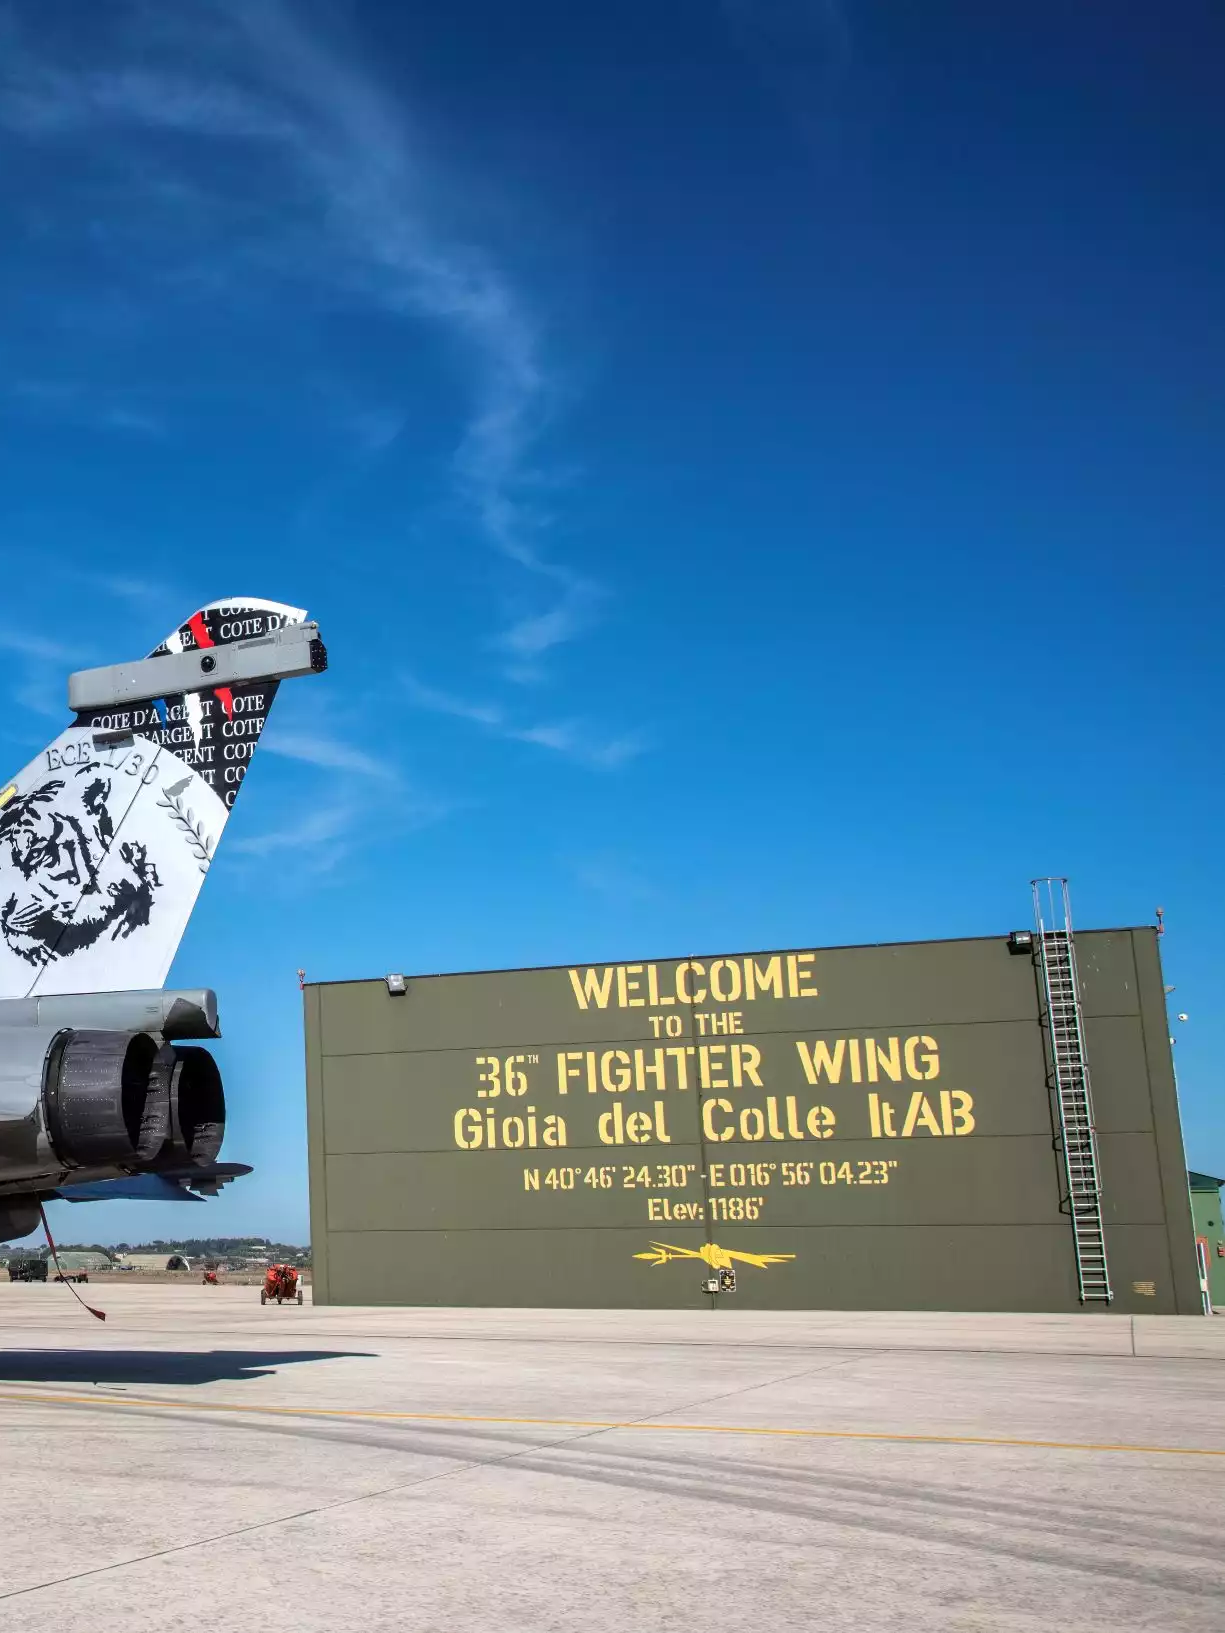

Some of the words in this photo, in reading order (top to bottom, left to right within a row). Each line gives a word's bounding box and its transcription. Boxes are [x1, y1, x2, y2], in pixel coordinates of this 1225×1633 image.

[219, 617, 263, 639] COTE
[568, 954, 819, 1010] WELCOME
[648, 1015, 683, 1038] TO
[693, 1011, 744, 1036] THE
[557, 1044, 764, 1094] FIGHTER
[796, 1035, 940, 1085] WING
[453, 1105, 567, 1149] Gioia
[598, 1100, 671, 1145] del
[702, 1096, 836, 1142] Colle
[647, 1198, 704, 1221] Elev:
